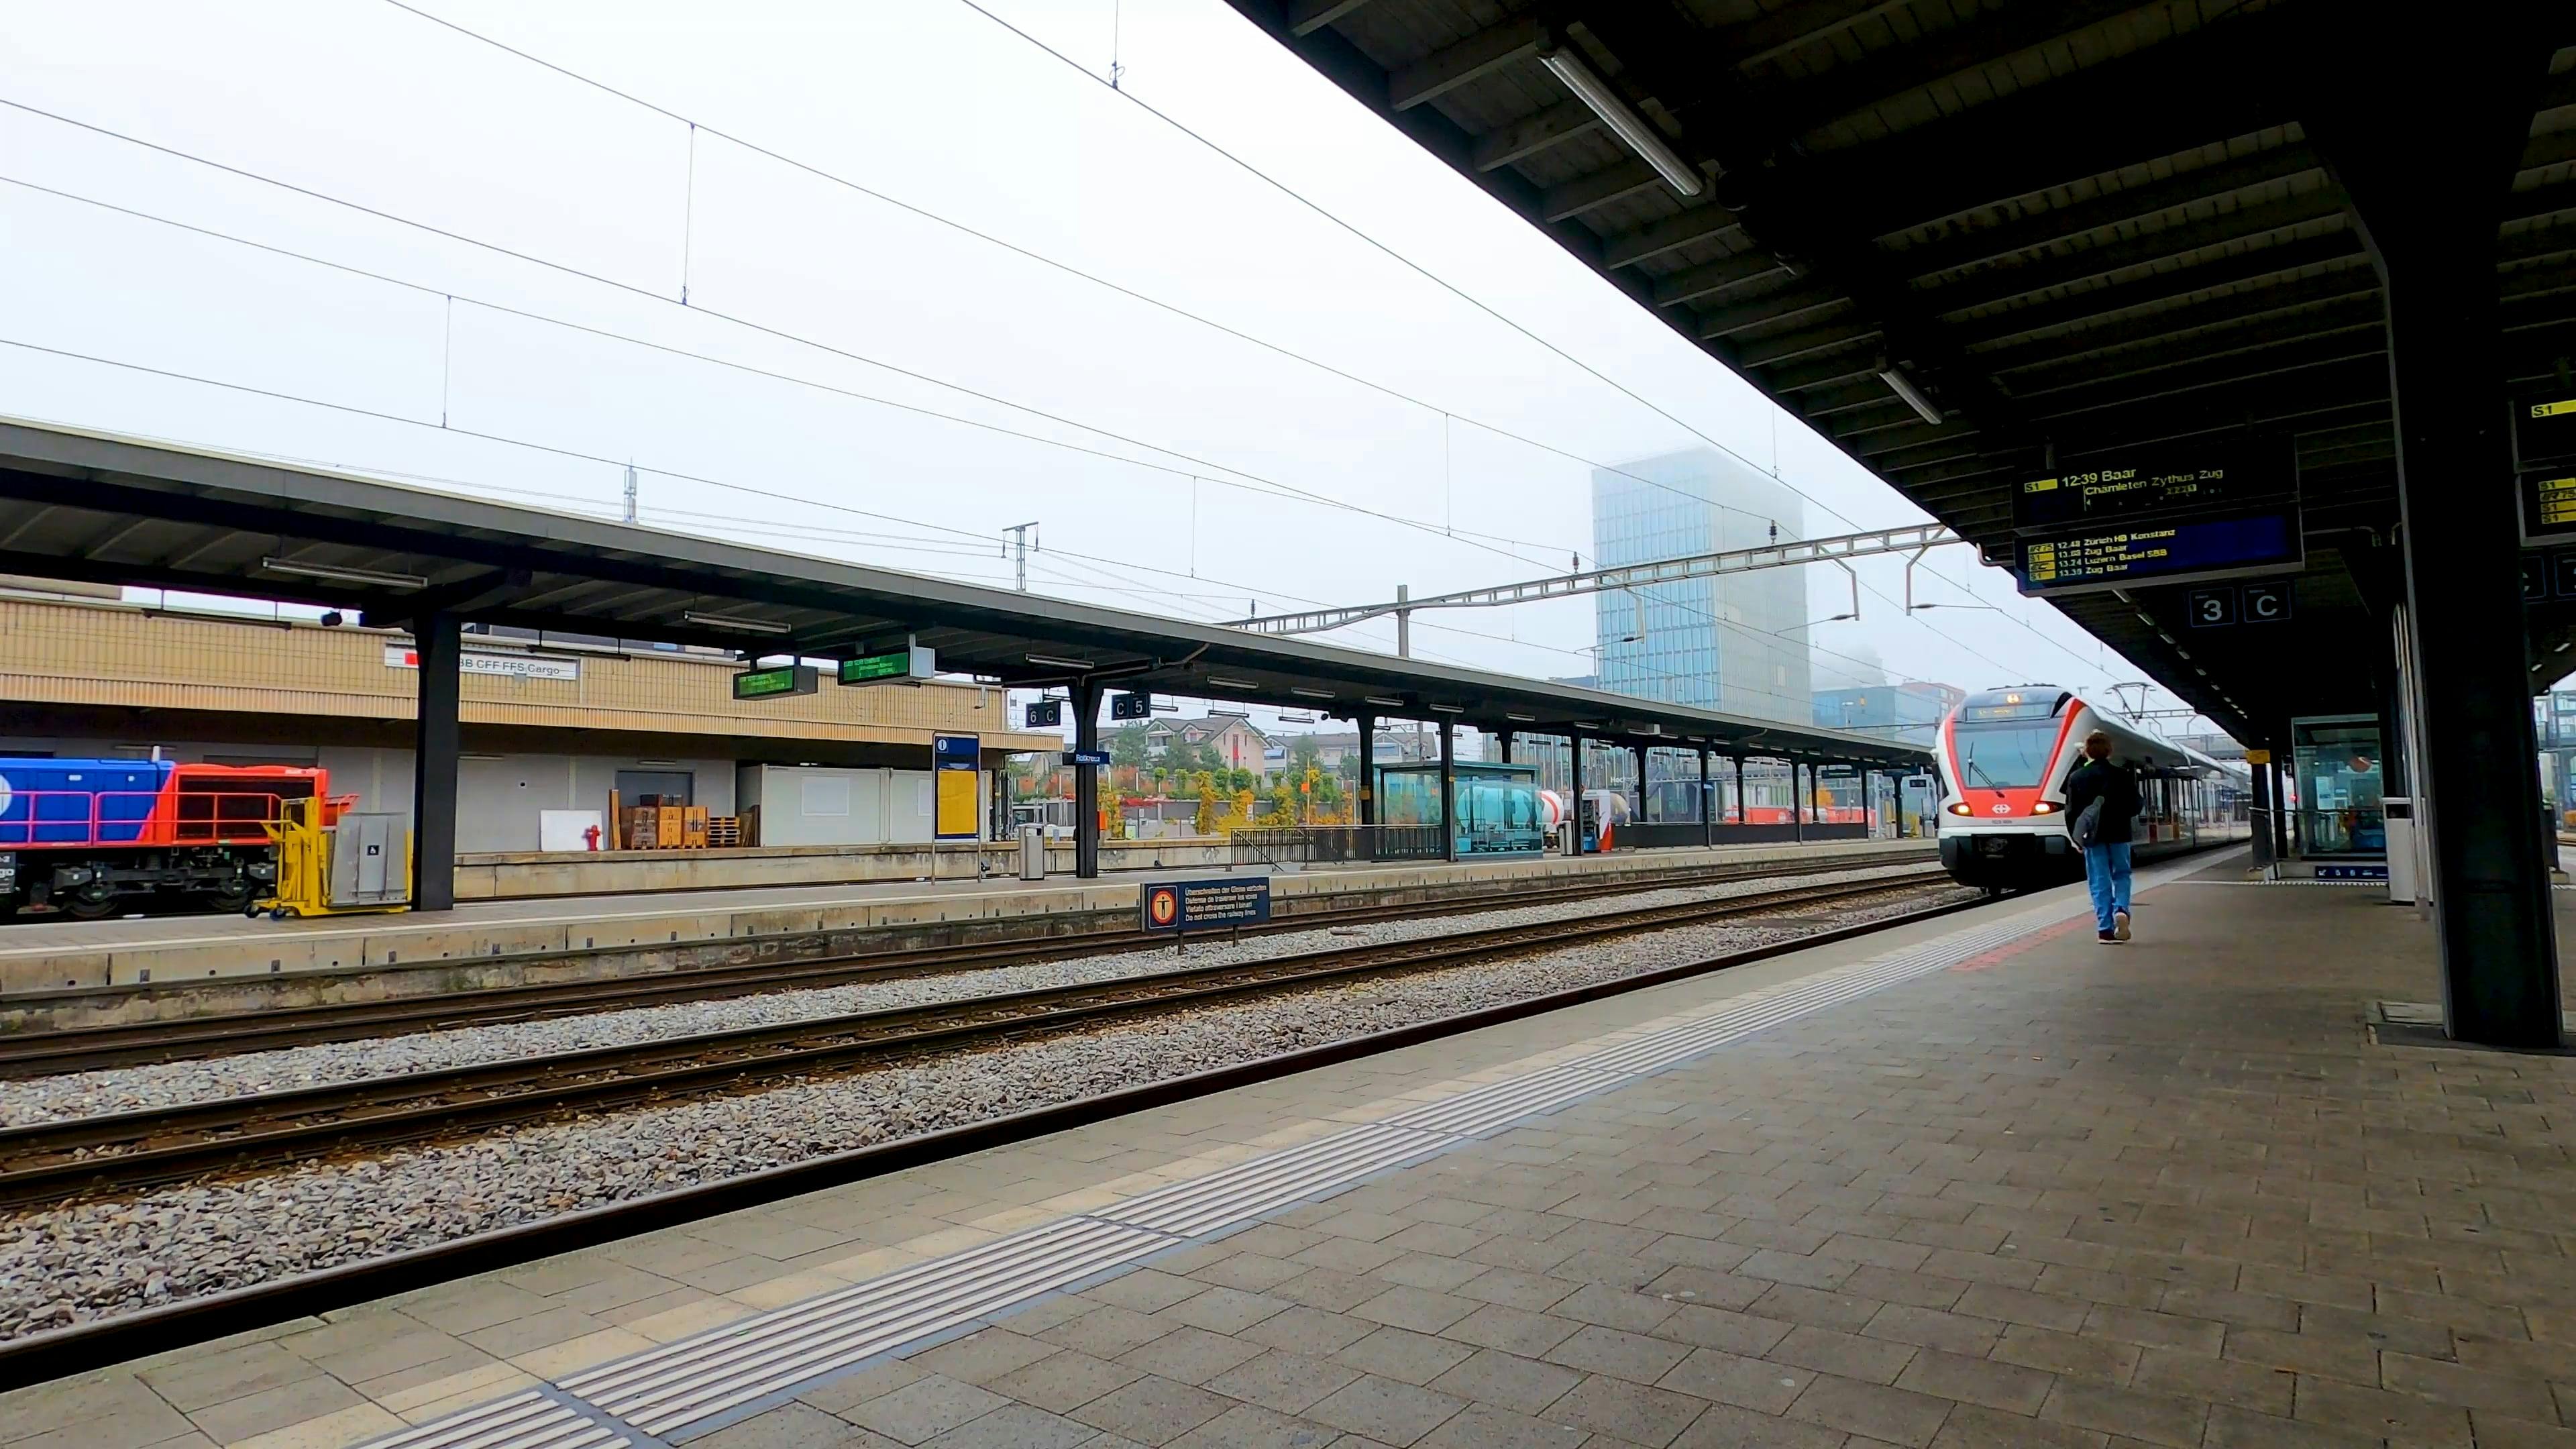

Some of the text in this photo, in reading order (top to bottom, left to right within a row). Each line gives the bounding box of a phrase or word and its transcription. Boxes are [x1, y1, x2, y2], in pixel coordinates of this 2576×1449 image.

[2533, 405, 2553, 416] S1
[2025, 482, 2039, 492] S1
[2101, 469, 2137, 482] Baar
[2198, 469, 2223, 479] Zug
[2084, 547, 2102, 556] Zug
[2203, 599, 2222, 621] 3
[2256, 595, 2278, 616] C
[477, 660, 499, 669] CFF
[502, 662, 525, 672] FFS
[528, 664, 559, 676] Cargo
[1116, 702, 1124, 715] C
[1135, 700, 1143, 714] 5
[1030, 711, 1036, 722] 6
[1046, 710, 1054, 722] C
